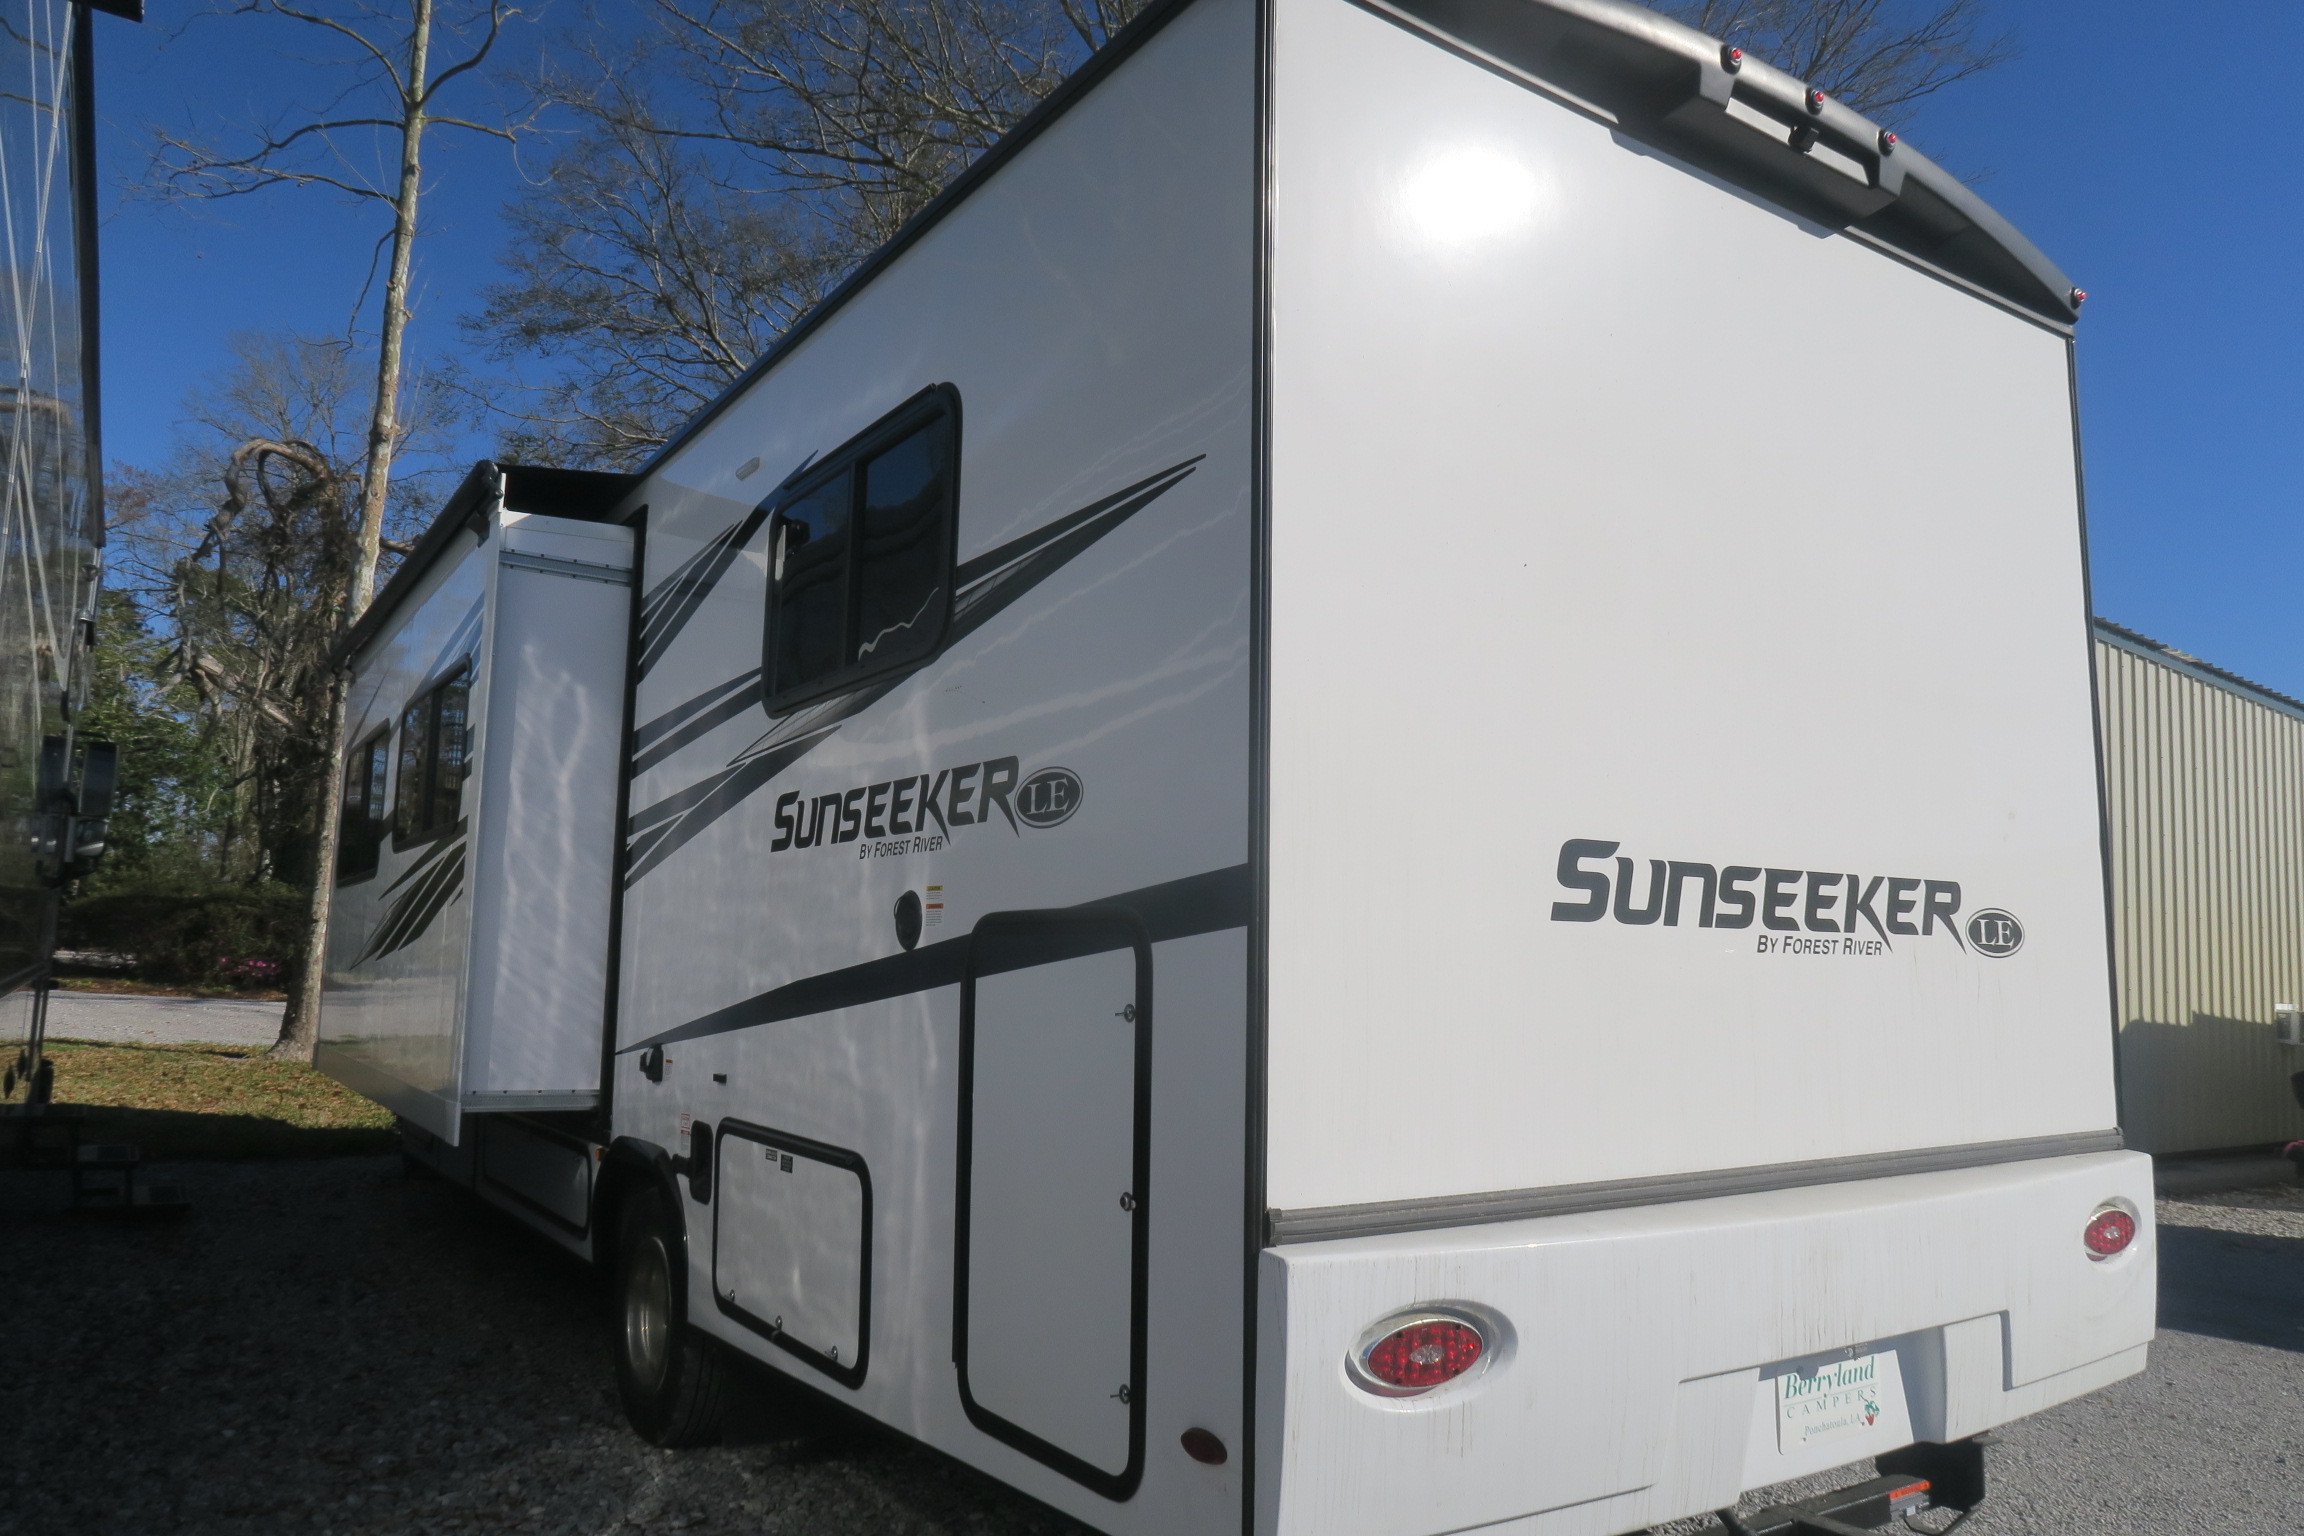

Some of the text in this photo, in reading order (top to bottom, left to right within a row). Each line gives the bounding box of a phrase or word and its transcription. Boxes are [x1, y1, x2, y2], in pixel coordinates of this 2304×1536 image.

[770, 755, 1020, 853] SUNSEEKER
[859, 836, 943, 860] BY FOREST RIVER
[1550, 838, 1967, 955] SUNSEEKER
[1756, 934, 1883, 956] BY FOREST RIVER
[1785, 1356, 1874, 1399] Berryland
[1786, 1386, 1877, 1419] CAMPERS
